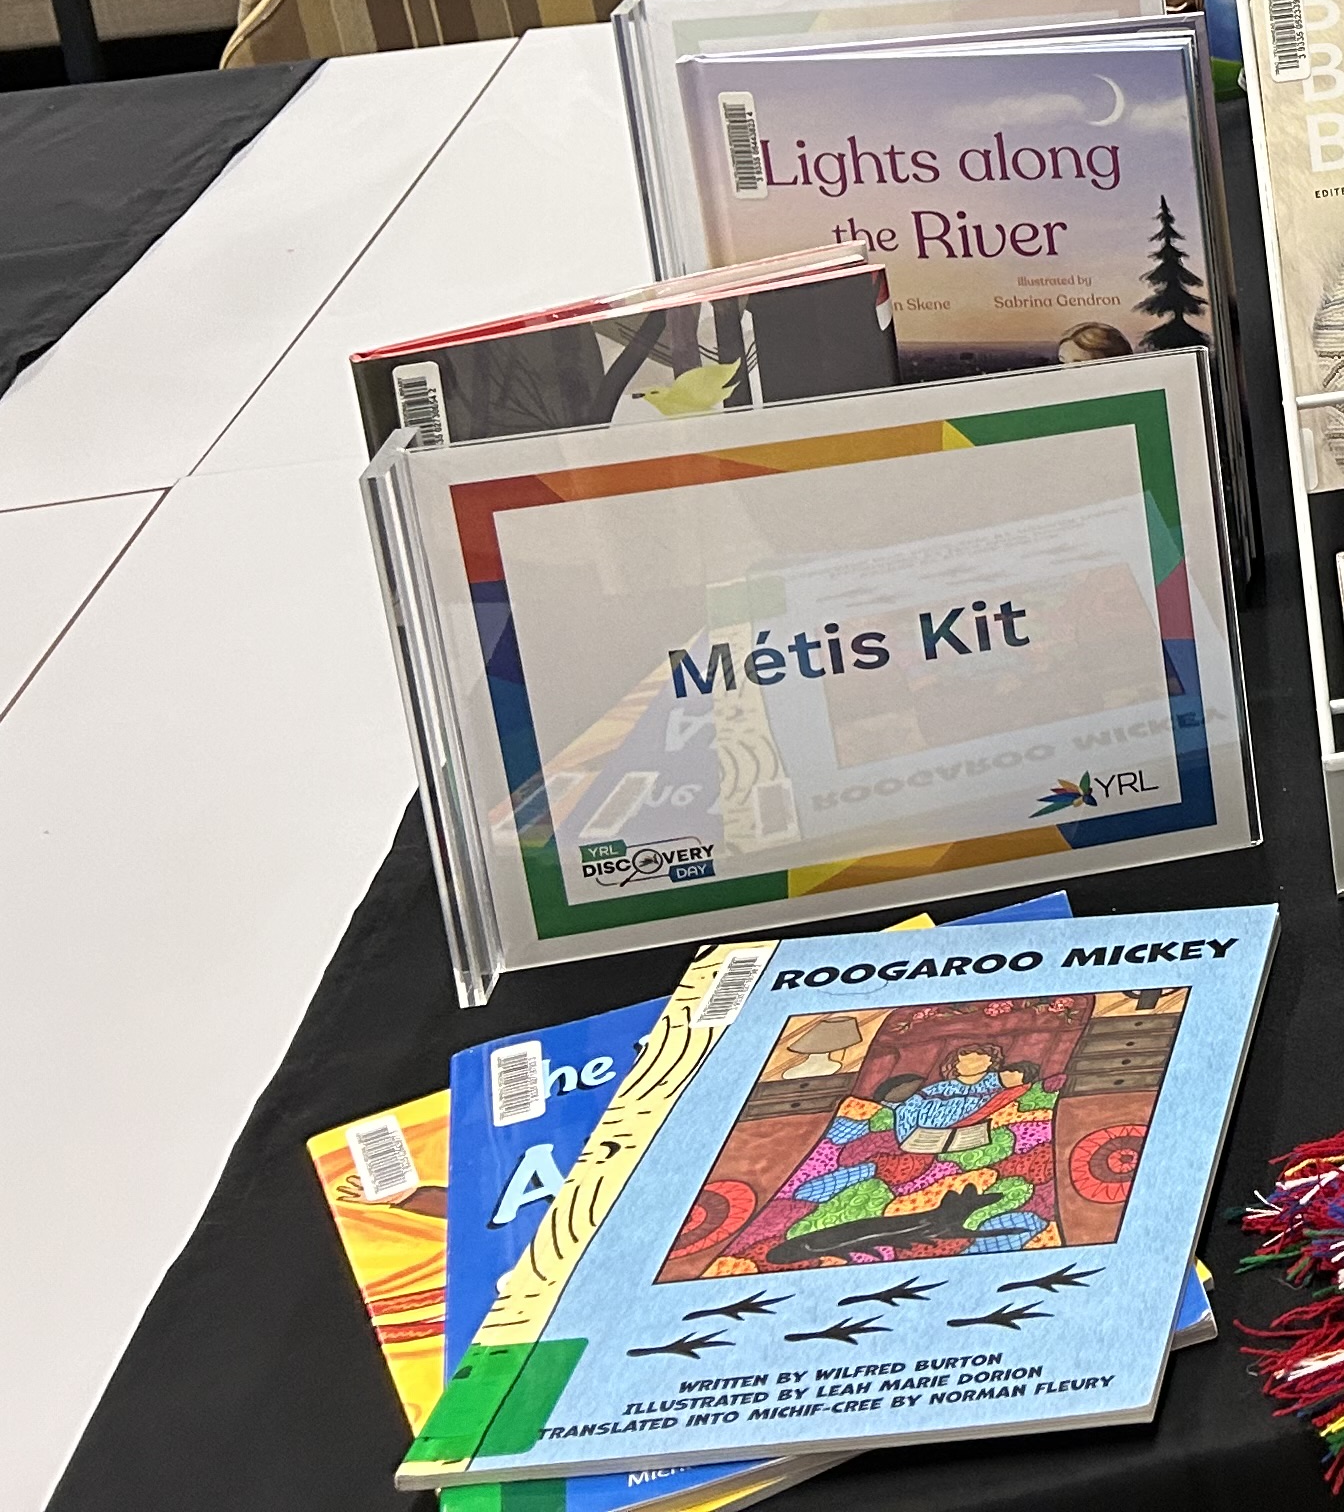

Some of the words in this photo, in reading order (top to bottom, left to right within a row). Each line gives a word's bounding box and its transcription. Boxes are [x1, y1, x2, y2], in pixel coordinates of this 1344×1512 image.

[760, 135, 940, 198] Lights
[958, 131, 1122, 190] along
[832, 216, 899, 253] the
[911, 209, 1067, 260] River
[907, 297, 951, 311] Skene
[994, 295, 1052, 310] Sabrina
[1057, 293, 1121, 308] Gendron
[668, 623, 890, 699] Métis
[919, 600, 1030, 661] Kit
[1093, 770, 1159, 799] YRL
[588, 845, 620, 858] YRL
[676, 864, 708, 879] DAY
[770, 951, 1042, 991] ROOGAROO
[1061, 938, 1239, 967] MICKEY
[622, 1389, 769, 1416] ILLUSTRATED
[777, 1386, 807, 1402] BY
[816, 1379, 869, 1397] LEAH
[878, 1374, 949, 1393] MARIE
[957, 1364, 1043, 1385] DORION
[679, 1373, 768, 1394] WRITTEN
[776, 1369, 807, 1384] BY
[815, 1361, 906, 1382] WILFRED
[915, 1352, 1003, 1371] BURTON
